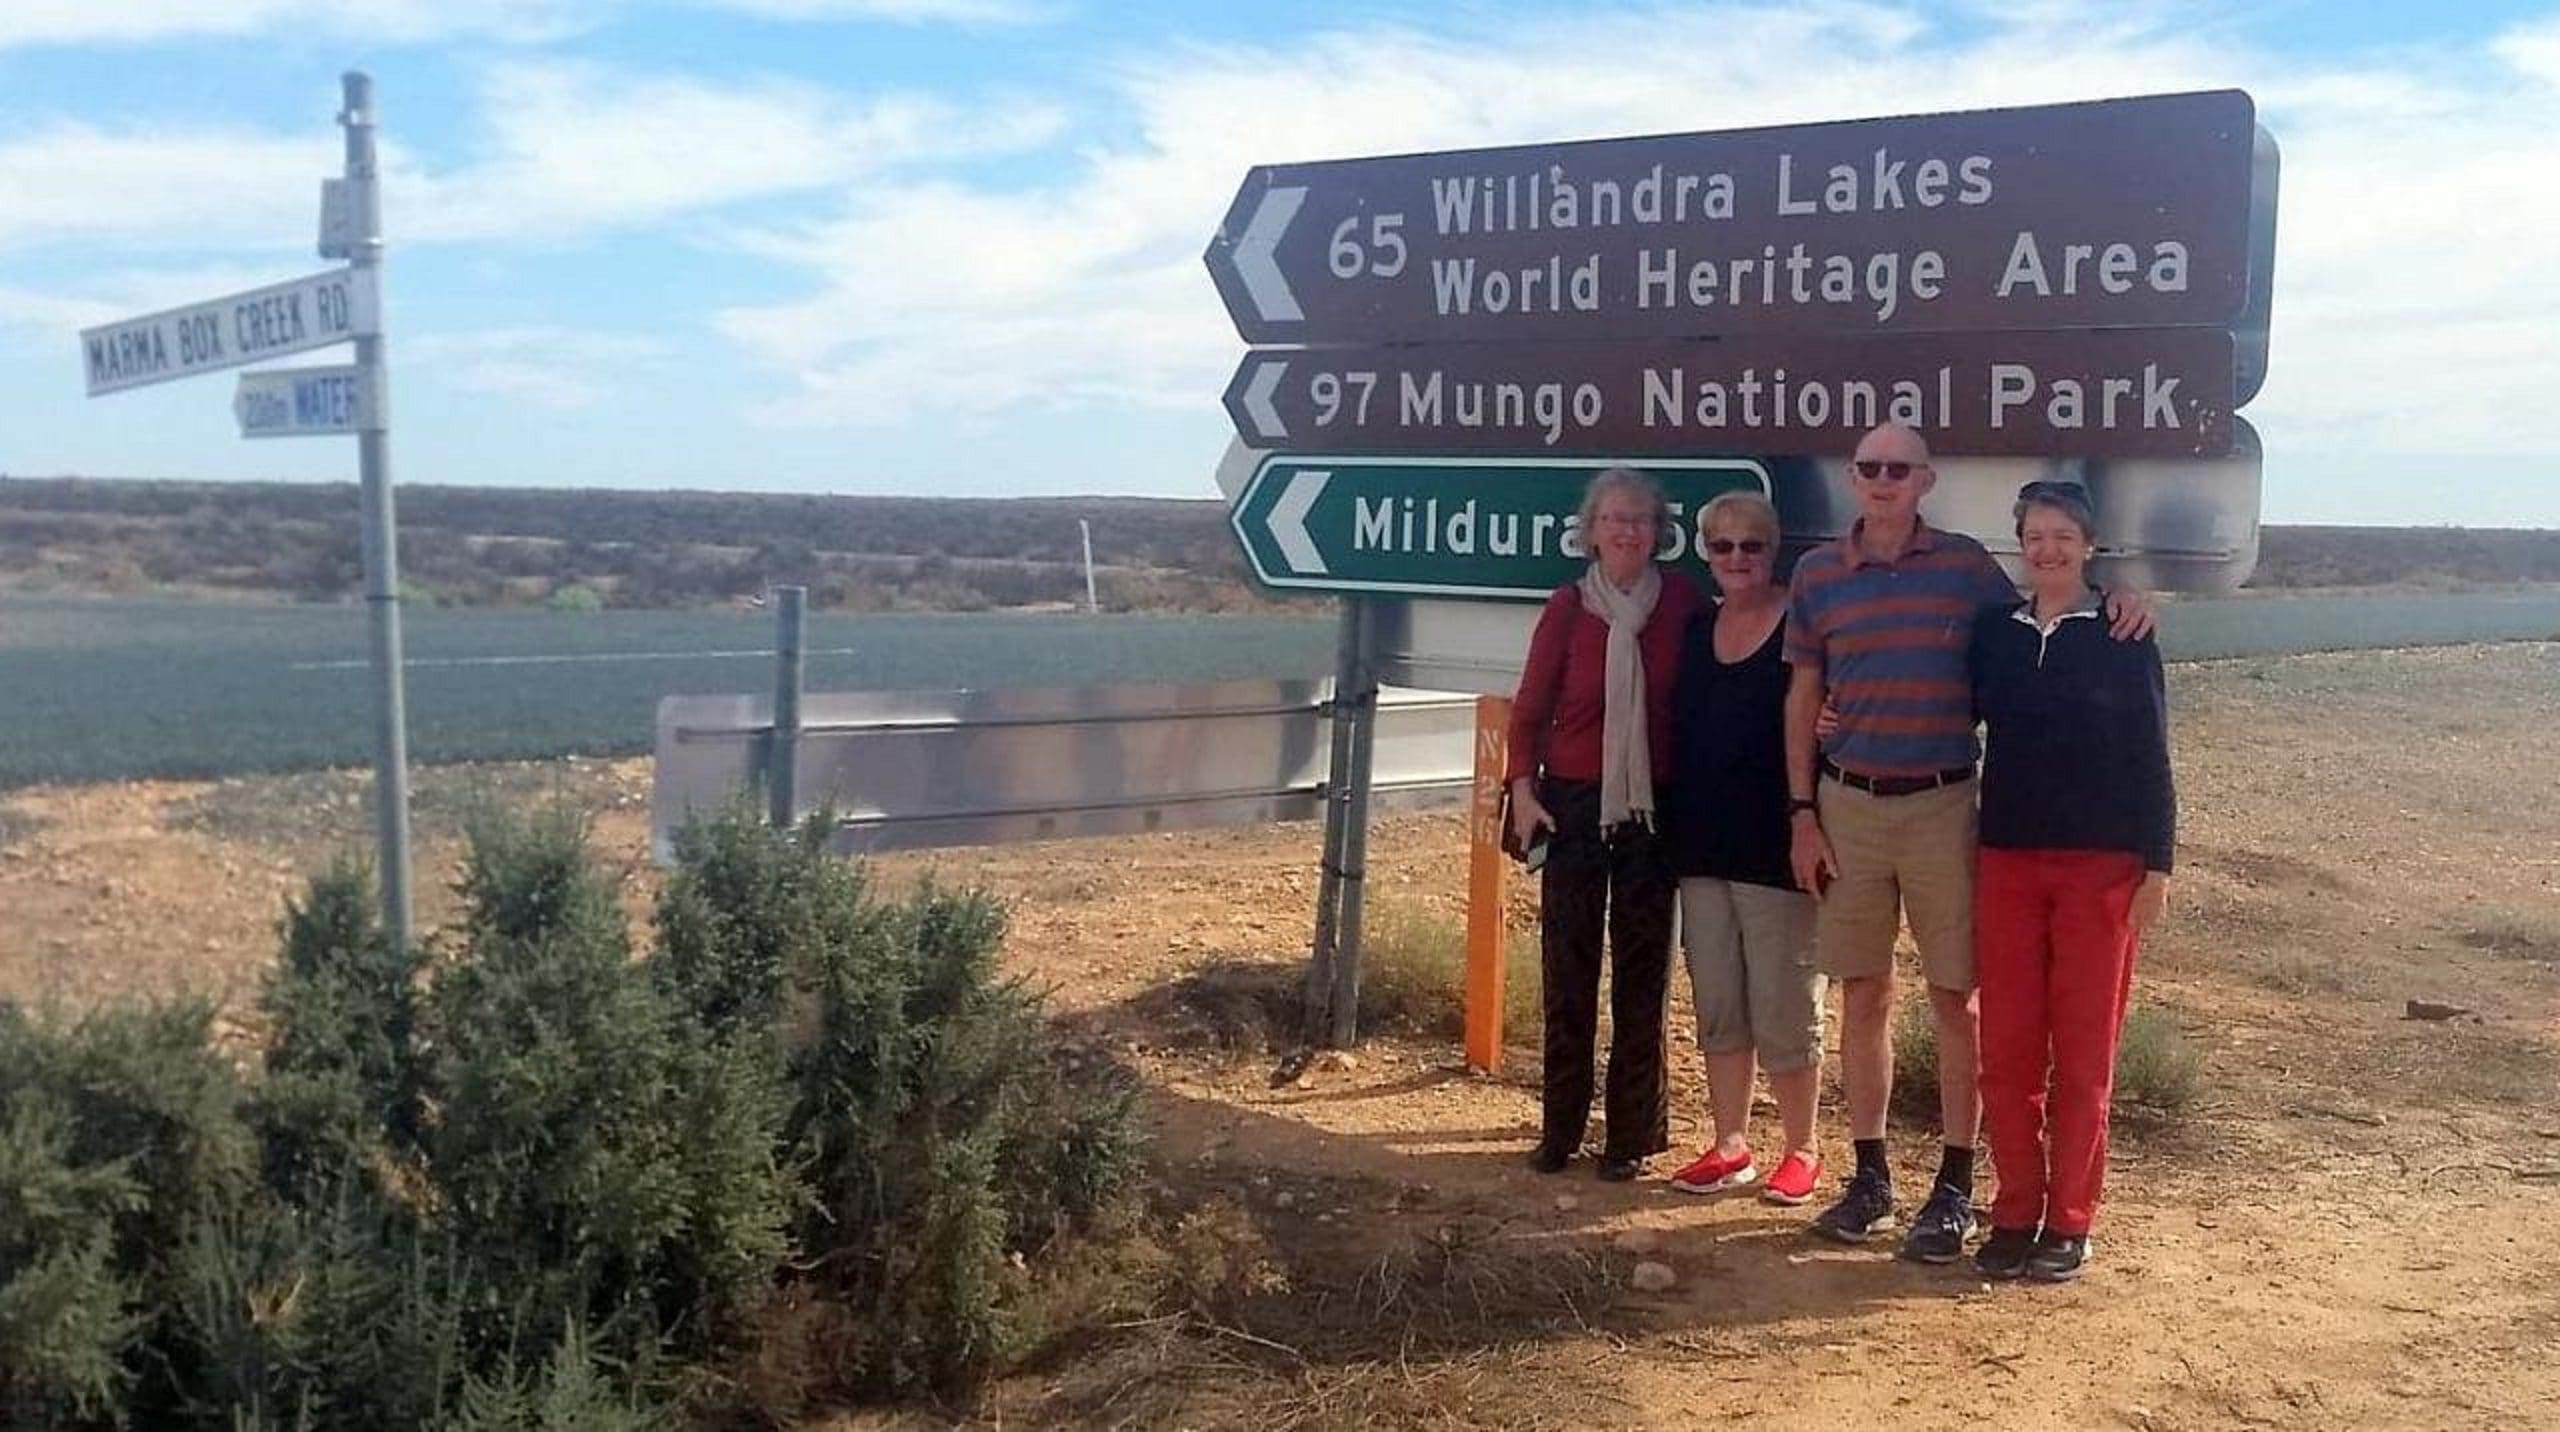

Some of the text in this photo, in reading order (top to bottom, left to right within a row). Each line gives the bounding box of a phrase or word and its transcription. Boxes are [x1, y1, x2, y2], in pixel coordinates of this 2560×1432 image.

[1432, 148, 1995, 235] Willandra Lakes
[1329, 213, 1408, 279] 65
[1432, 230, 2190, 322] World Heritage Area
[88, 282, 350, 382] MARMA BOX CREEK RD
[1310, 362, 2182, 445] 97 Mungo National Park
